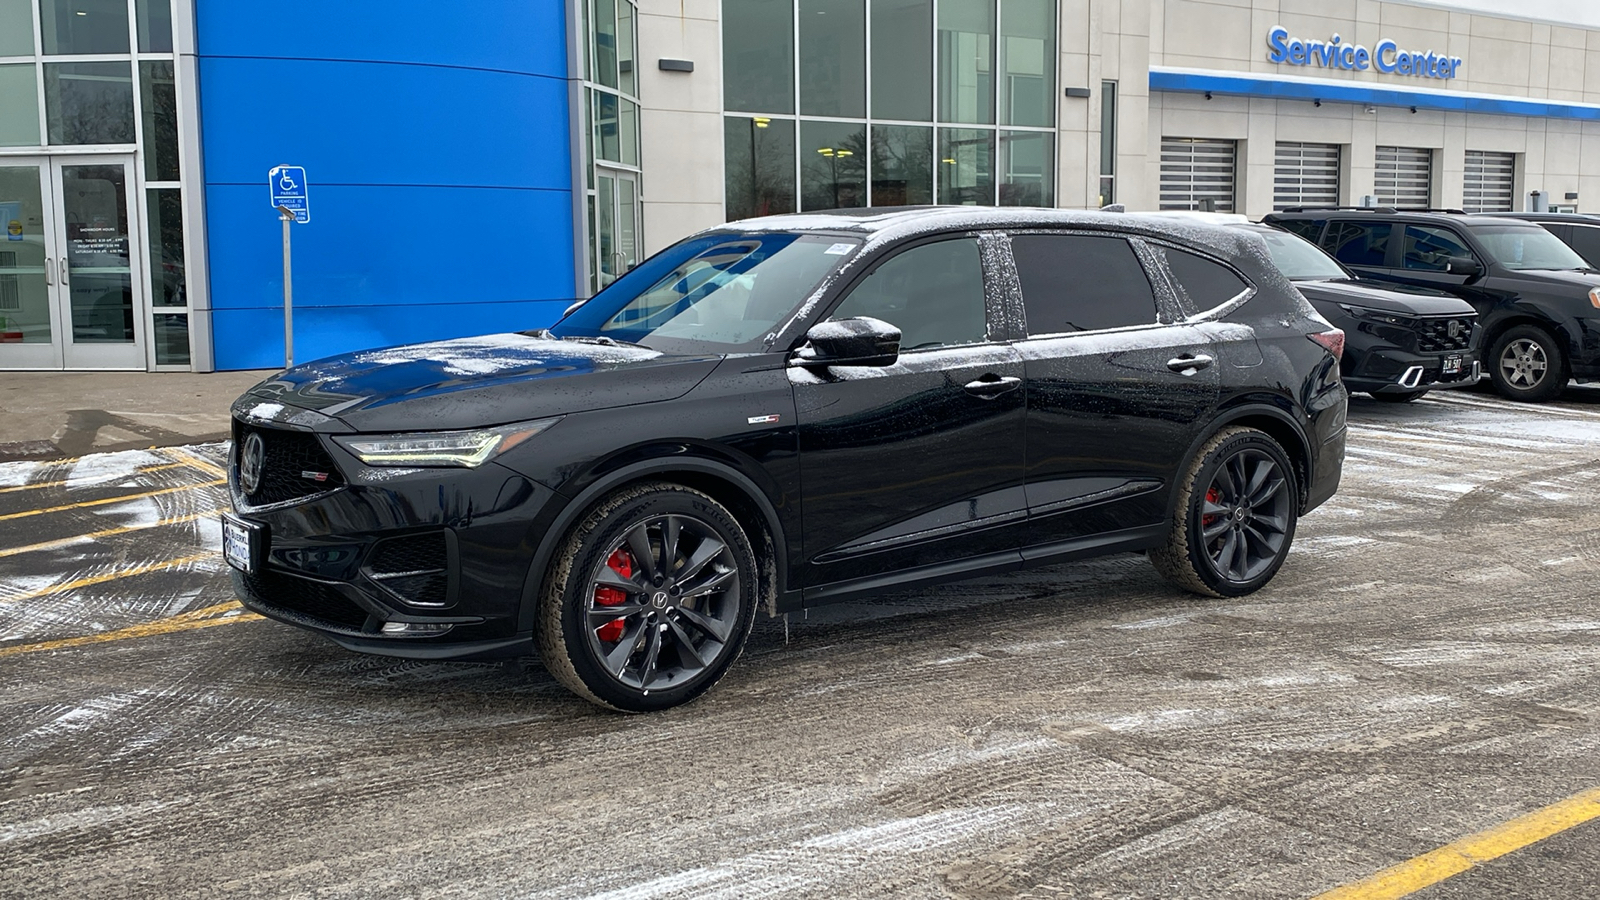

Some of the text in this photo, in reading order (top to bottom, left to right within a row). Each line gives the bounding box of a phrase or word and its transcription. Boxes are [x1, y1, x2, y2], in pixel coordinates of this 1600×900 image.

[1267, 25, 1462, 79] Service Center
[231, 529, 249, 546] BUERKL
[705, 506, 743, 545] MICHELIN
[230, 539, 250, 560] HOND
